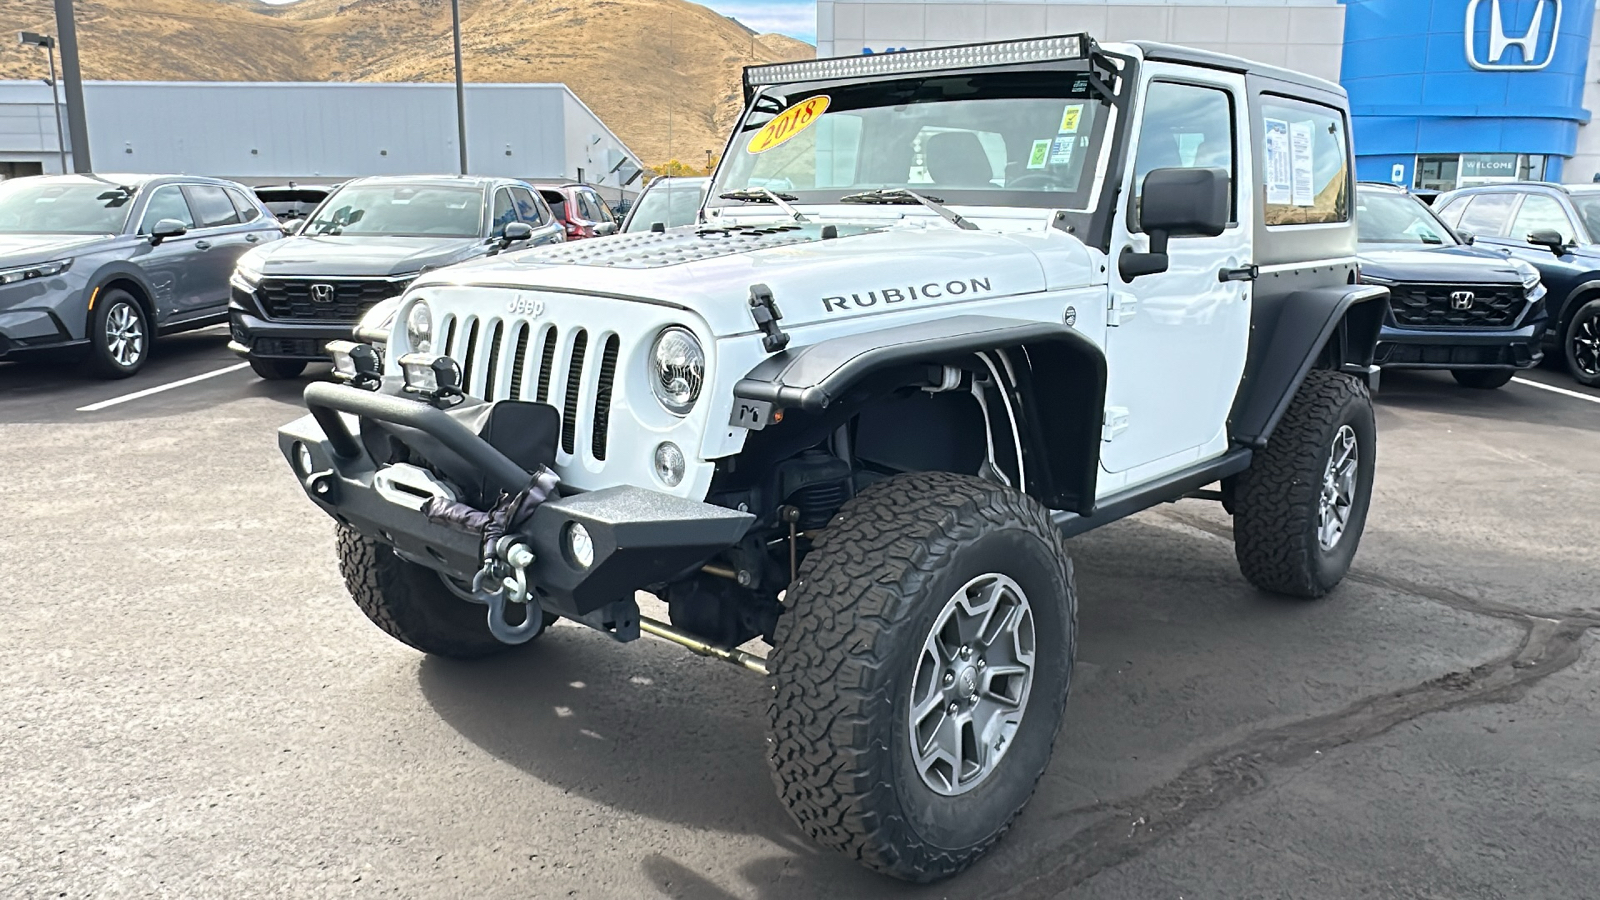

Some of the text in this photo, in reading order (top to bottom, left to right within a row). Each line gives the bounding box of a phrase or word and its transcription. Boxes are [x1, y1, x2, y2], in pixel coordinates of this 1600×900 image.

[760, 100, 817, 149] 2018
[1466, 161, 1513, 169] WELCOME
[507, 294, 545, 320] Jeep
[821, 277, 992, 312] RUBICON
